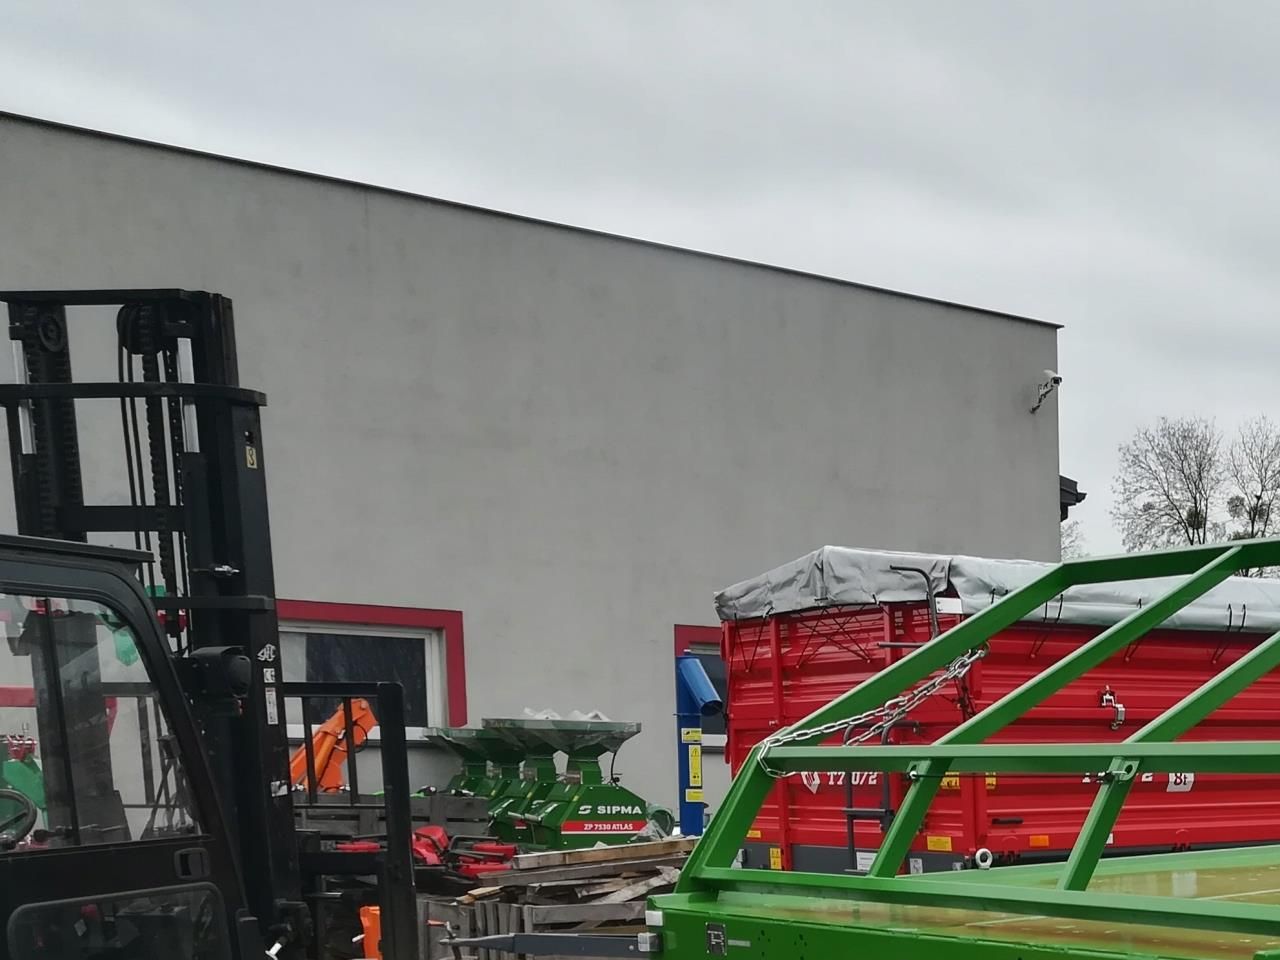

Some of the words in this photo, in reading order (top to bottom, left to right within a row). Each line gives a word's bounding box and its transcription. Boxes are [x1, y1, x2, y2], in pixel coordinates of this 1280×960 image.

[827, 771, 878, 785] T70/2
[597, 805, 642, 815] SIPMA
[583, 823, 593, 831] ZP
[612, 823, 633, 831] ATLAS
